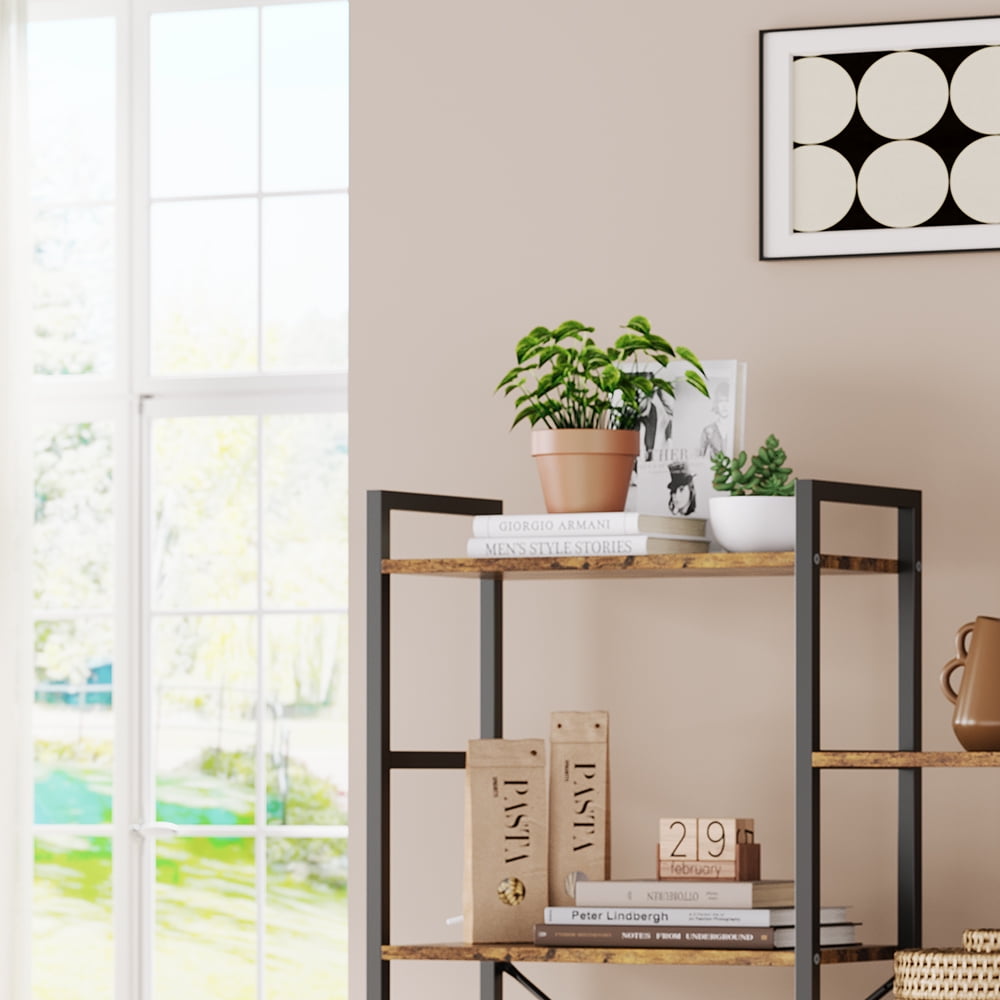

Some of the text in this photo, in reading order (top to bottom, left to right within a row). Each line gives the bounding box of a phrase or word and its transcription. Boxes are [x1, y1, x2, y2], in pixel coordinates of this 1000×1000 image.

[500, 519, 610, 531] GIORGIO ARMANI
[486, 540, 631, 556] MEN'S STYLE STORIES
[573, 764, 596, 851] PASTA
[503, 780, 530, 863] PASTA
[671, 860, 722, 878] february
[572, 910, 669, 923] Peter Lindbergh
[622, 931, 651, 940] NOTES
[656, 932, 682, 940] FROM
[685, 932, 754, 942] UNDERGROUND
